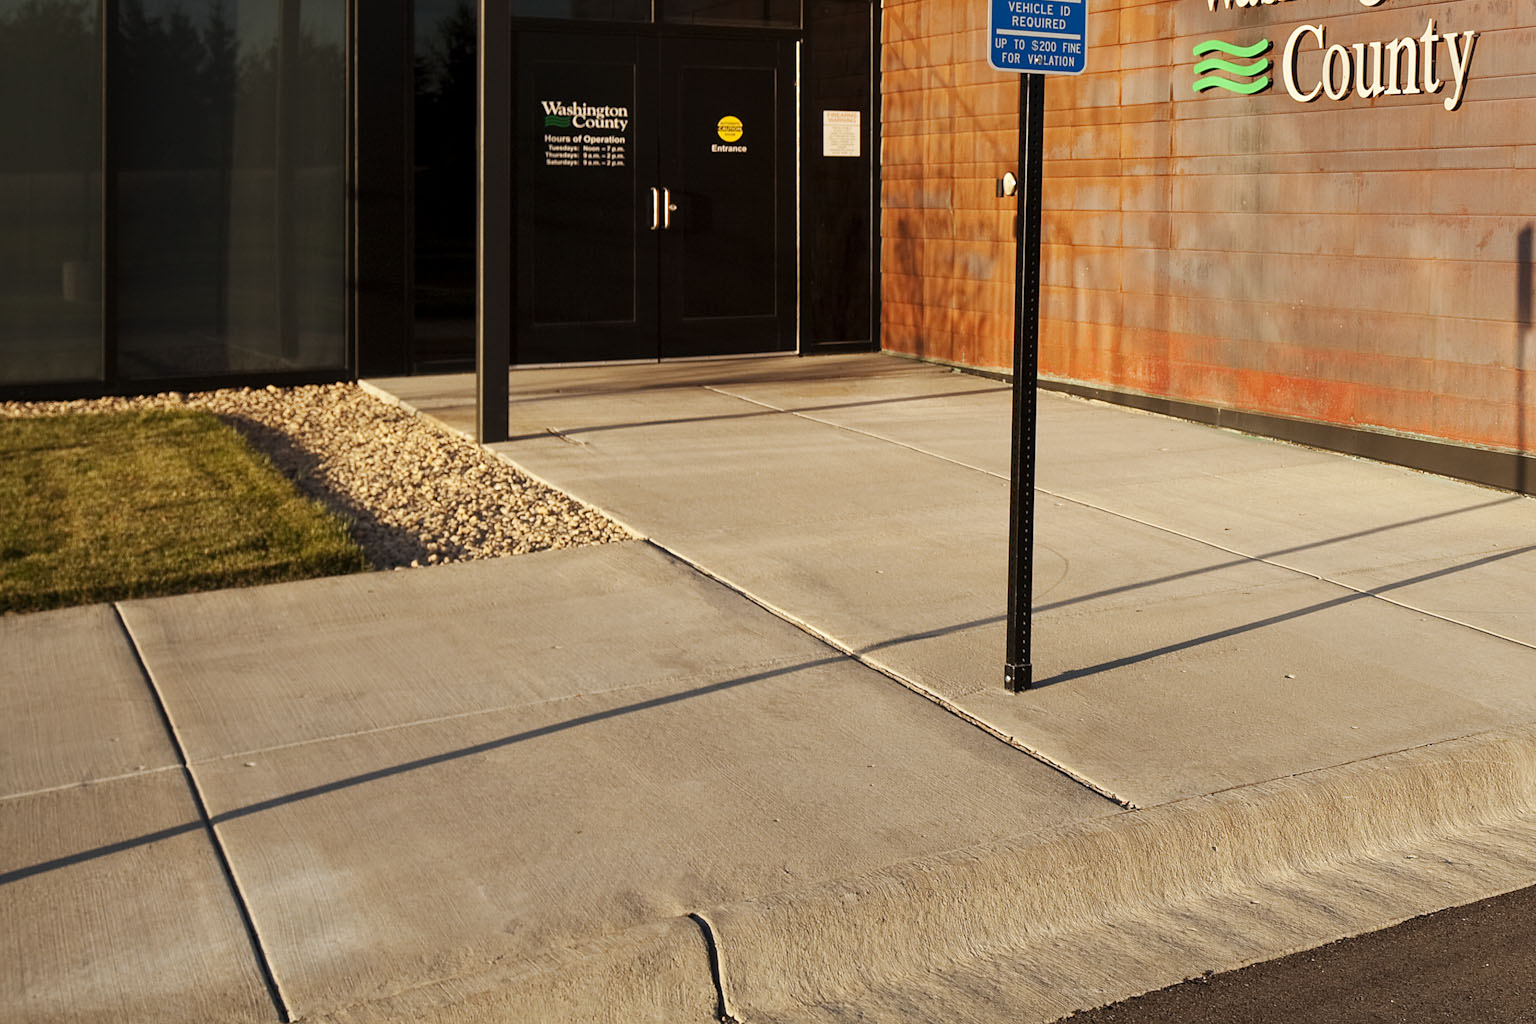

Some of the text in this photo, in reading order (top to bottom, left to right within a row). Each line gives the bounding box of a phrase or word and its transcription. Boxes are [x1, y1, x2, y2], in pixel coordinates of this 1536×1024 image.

[1008, 1, 1071, 17] VEHICLE ID
[1011, 15, 1066, 30] REQUIRED
[995, 37, 1008, 49] UP
[1014, 38, 1025, 50] TO
[1062, 42, 1082, 55] FINE
[1001, 52, 1075, 67] FOR VIOLATION
[1282, 18, 1477, 111] County
[541, 101, 628, 120] Washington
[572, 115, 628, 132] County
[544, 134, 626, 145] Hours of Operation
[711, 144, 748, 153] Entrance
